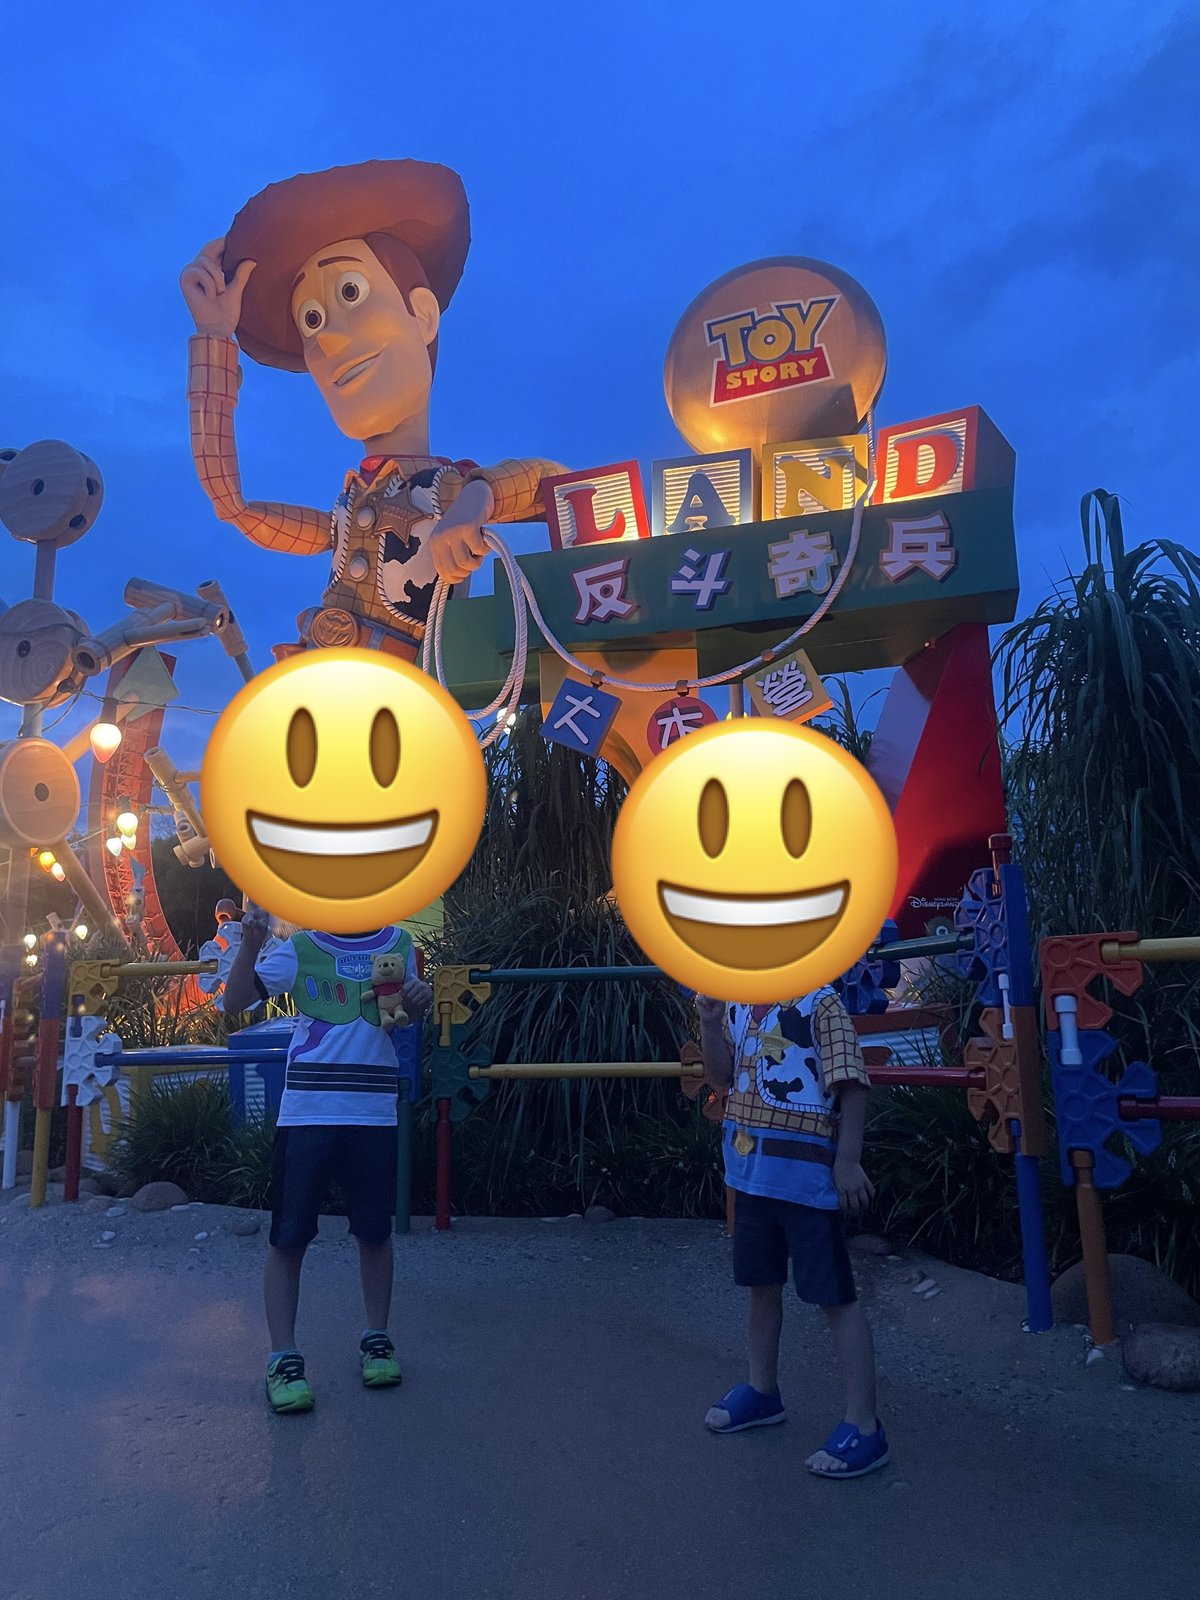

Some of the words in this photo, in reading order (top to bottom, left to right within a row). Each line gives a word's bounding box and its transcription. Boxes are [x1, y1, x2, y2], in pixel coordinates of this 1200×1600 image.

[706, 296, 838, 368] TOY
[726, 357, 818, 389] STORY
[563, 435, 957, 546] LAND
[572, 512, 957, 624] 反斗奇兵
